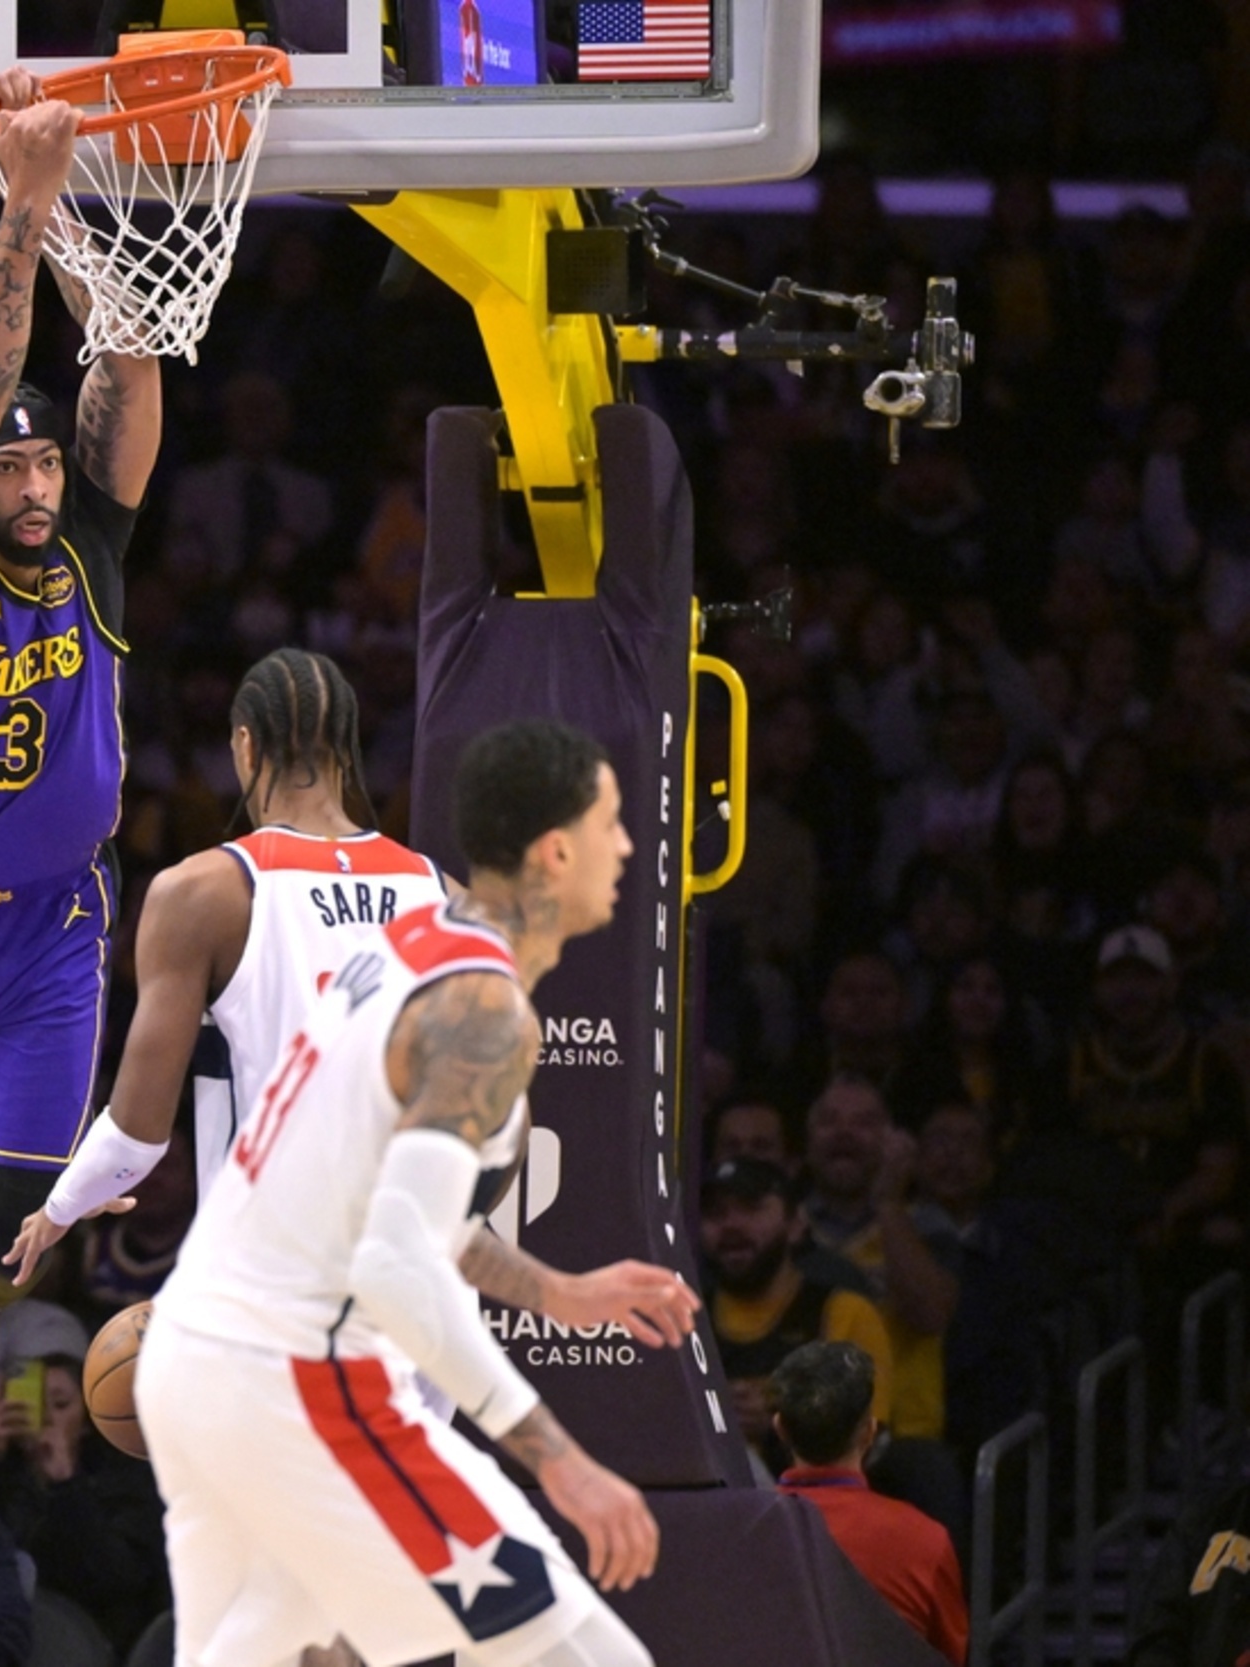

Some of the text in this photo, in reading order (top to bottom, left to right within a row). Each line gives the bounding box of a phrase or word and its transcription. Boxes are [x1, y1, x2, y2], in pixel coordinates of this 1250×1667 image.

[310, 882, 397, 928] SARR
[535, 1048, 619, 1066] CASINO
[527, 1345, 636, 1366] CASINO
